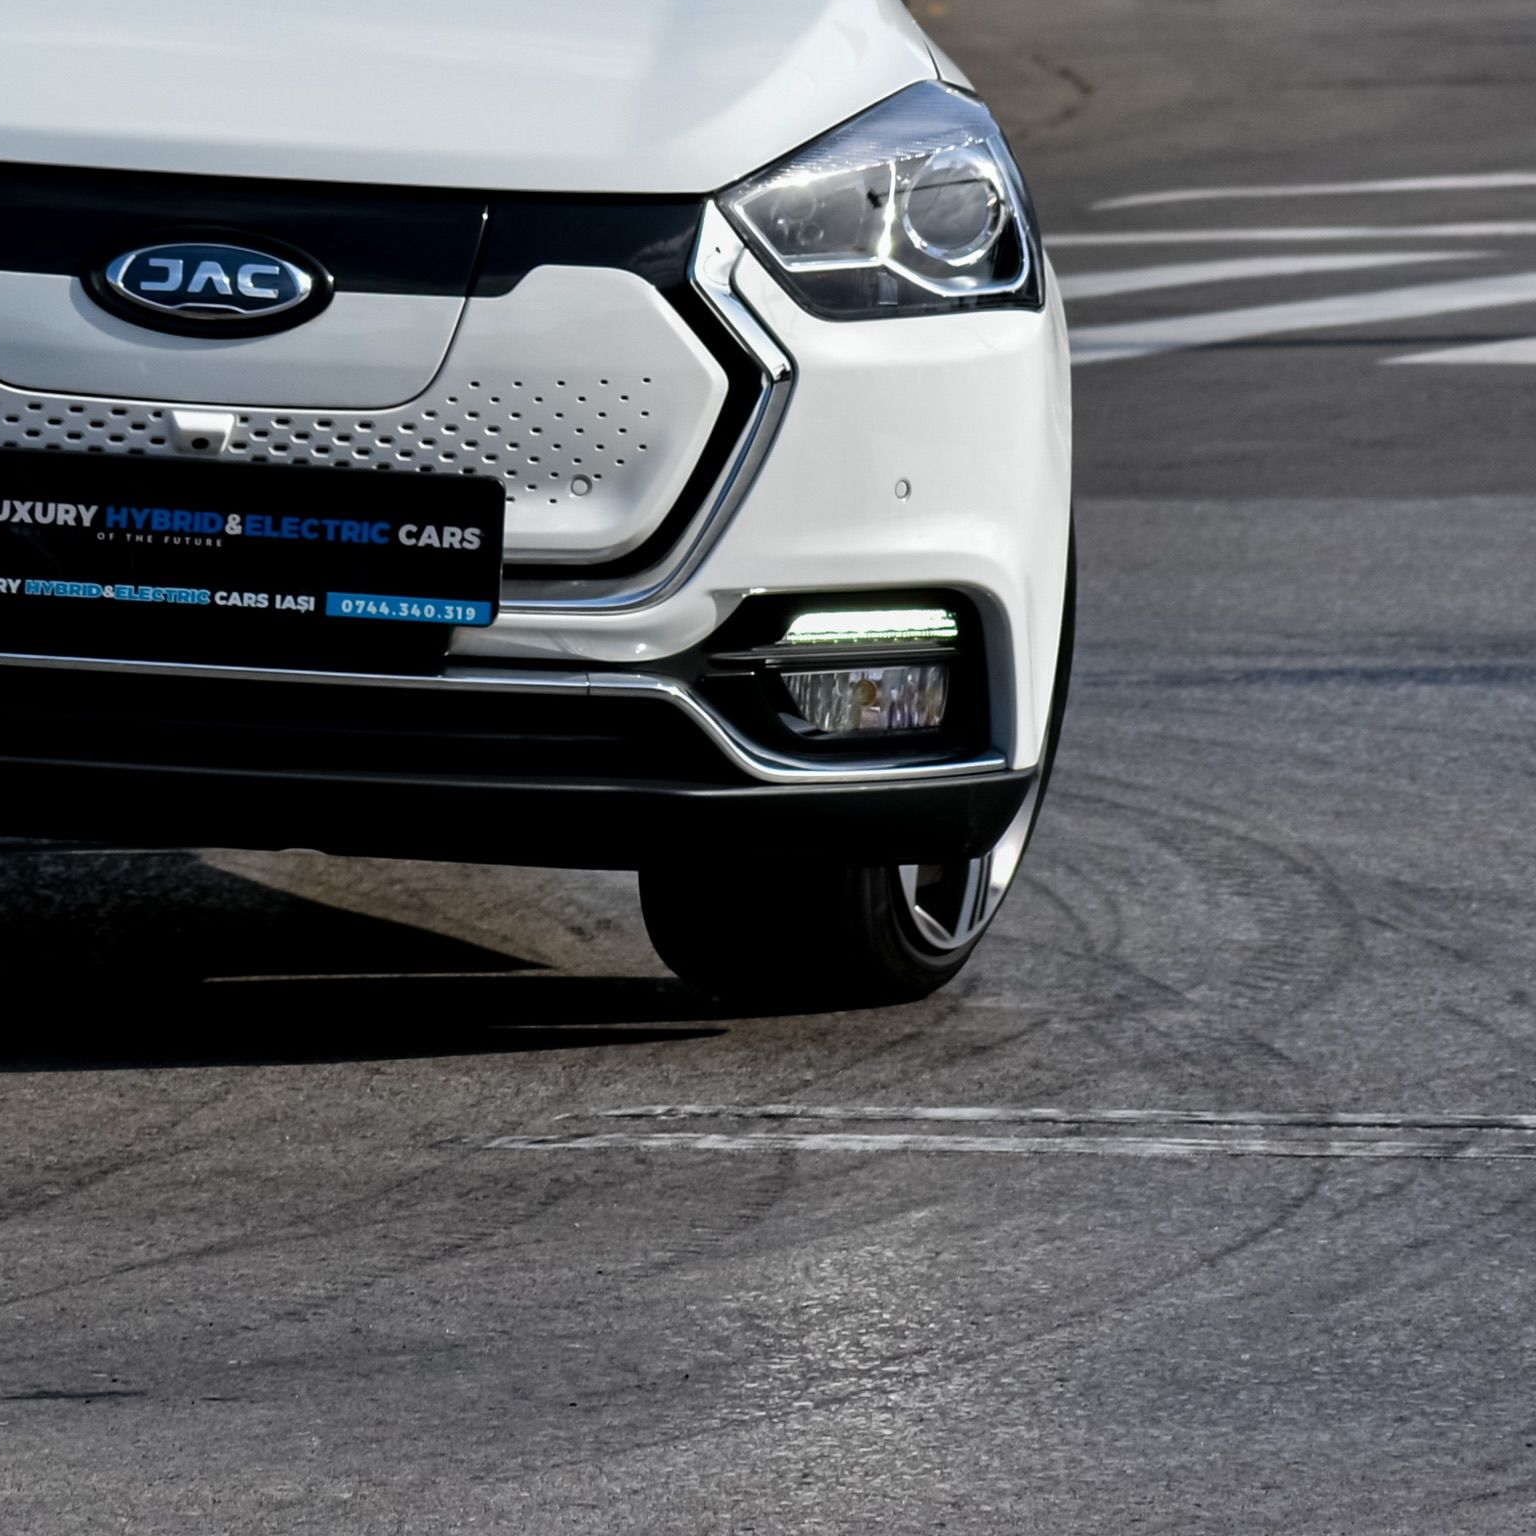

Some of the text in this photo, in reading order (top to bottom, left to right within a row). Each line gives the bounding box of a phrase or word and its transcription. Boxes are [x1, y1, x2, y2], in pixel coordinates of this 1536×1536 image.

[139, 258, 280, 299] JAC
[96, 531, 116, 542] OF
[125, 533, 154, 544] THE
[163, 535, 223, 548] FUTURE
[398, 523, 482, 551] CARS
[214, 590, 269, 609] CARS
[341, 598, 477, 622] 0744.340.319
